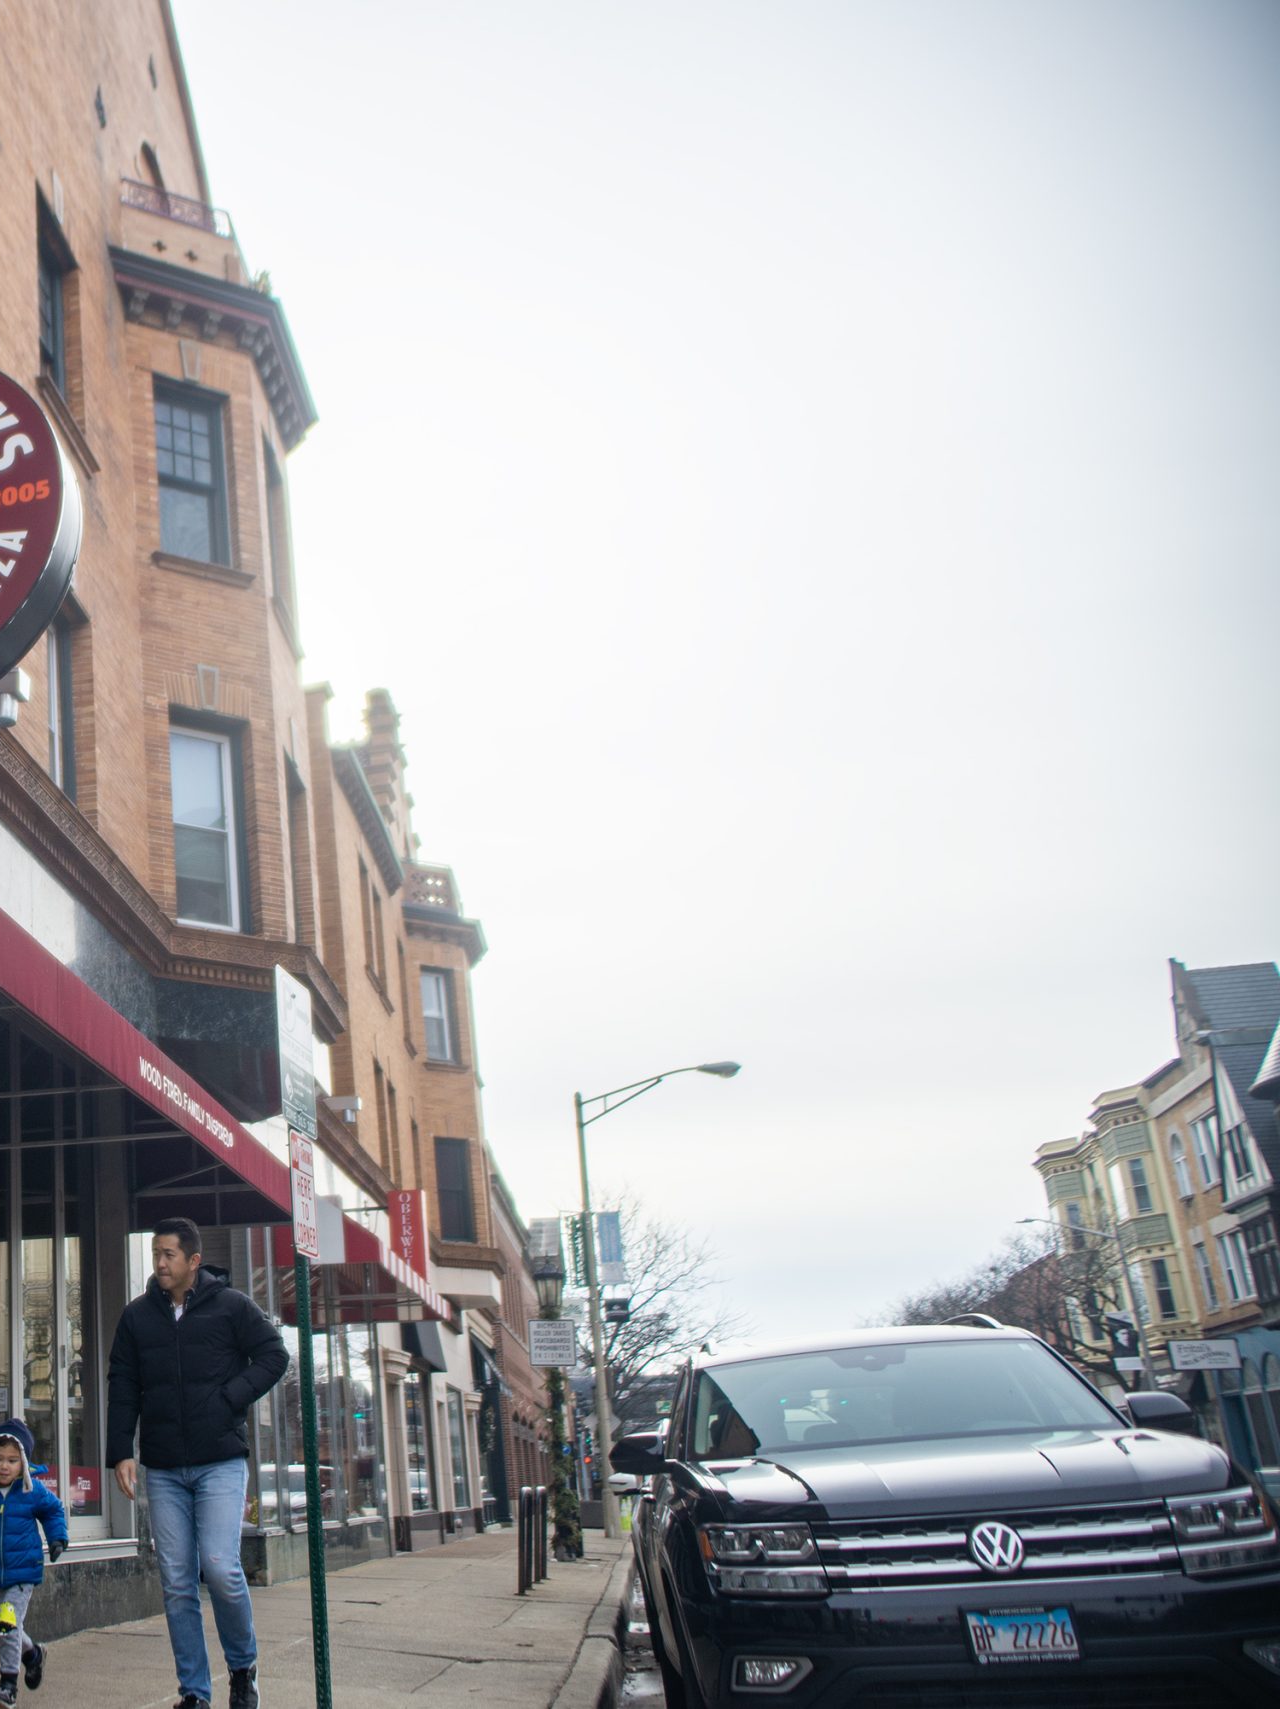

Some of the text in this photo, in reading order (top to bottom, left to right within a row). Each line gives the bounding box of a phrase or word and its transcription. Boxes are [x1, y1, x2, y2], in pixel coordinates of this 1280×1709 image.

[139, 1055, 162, 1091] WOOD
[183, 1092, 206, 1125] FAMILY
[296, 1176, 313, 1201] HERE
[301, 1201, 310, 1221] TO
[296, 1221, 317, 1249] CORNER
[398, 1191, 415, 1266] OBERWEI
[971, 1621, 1075, 1651] BP 22226
